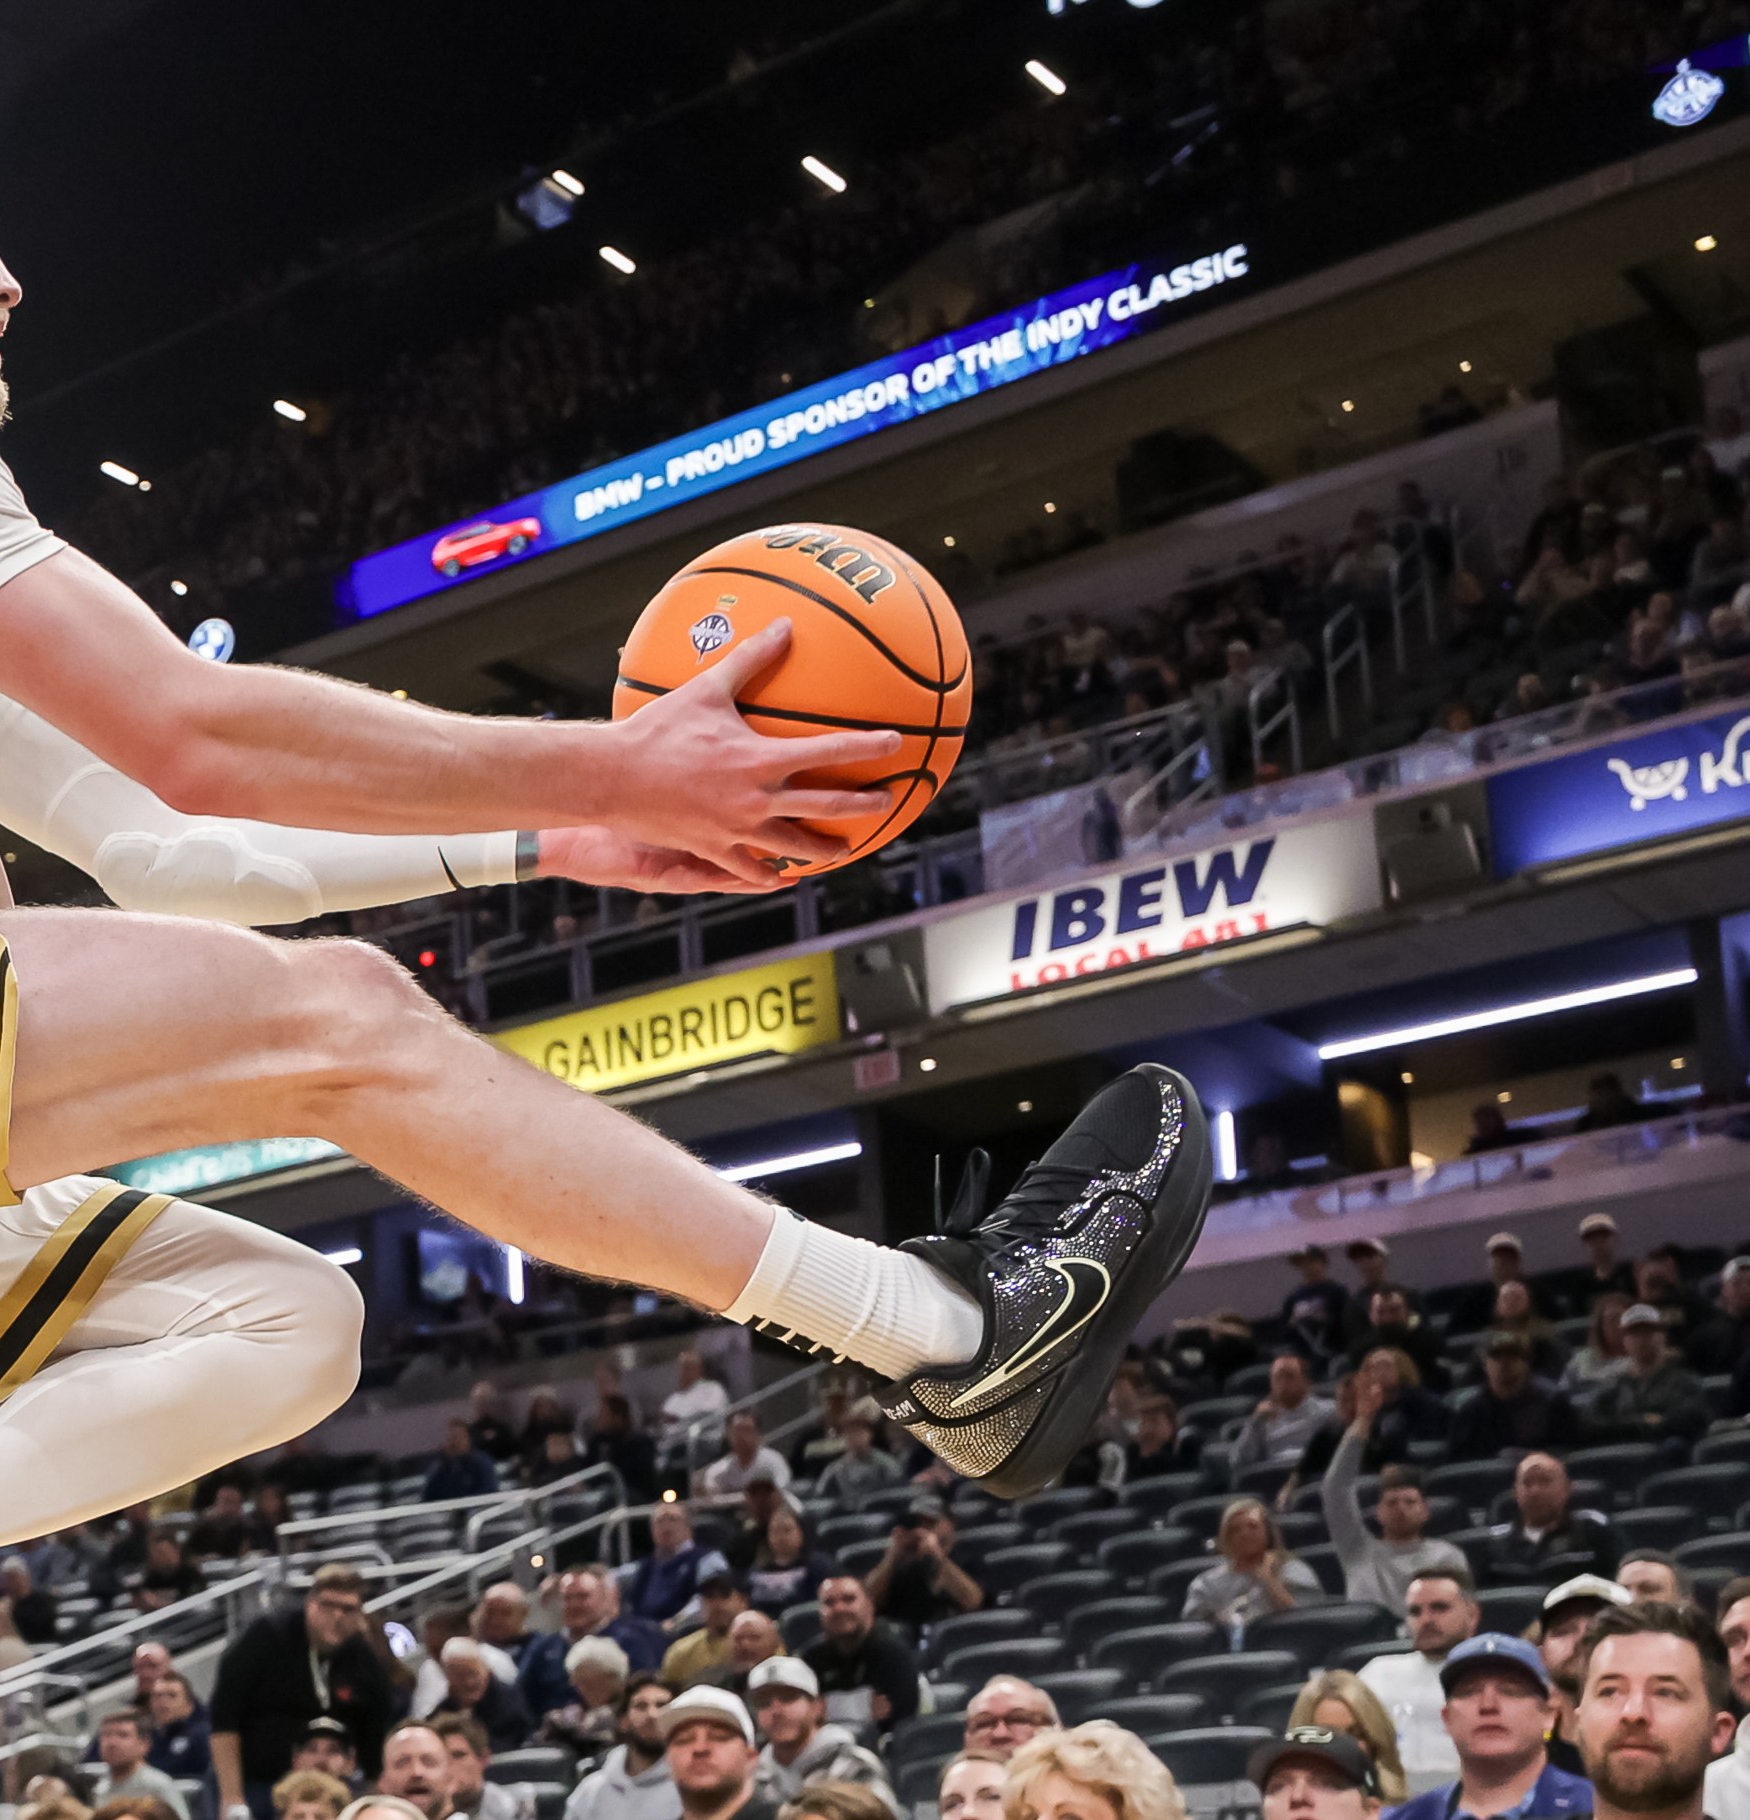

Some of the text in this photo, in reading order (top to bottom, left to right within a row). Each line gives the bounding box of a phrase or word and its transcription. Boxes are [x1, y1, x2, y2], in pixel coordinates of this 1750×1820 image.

[574, 472, 644, 521] BMW
[666, 428, 766, 486] PROUD
[766, 373, 909, 449] SPONSOR
[912, 354, 956, 394] OF
[956, 328, 1025, 376] THE
[1026, 298, 1103, 352] INDY
[1106, 243, 1248, 321] CLASSIC
[1012, 836, 1277, 961] IBEW
[1011, 943, 1157, 991] LOCAL
[545, 976, 816, 1080] GAINBRIDGE
